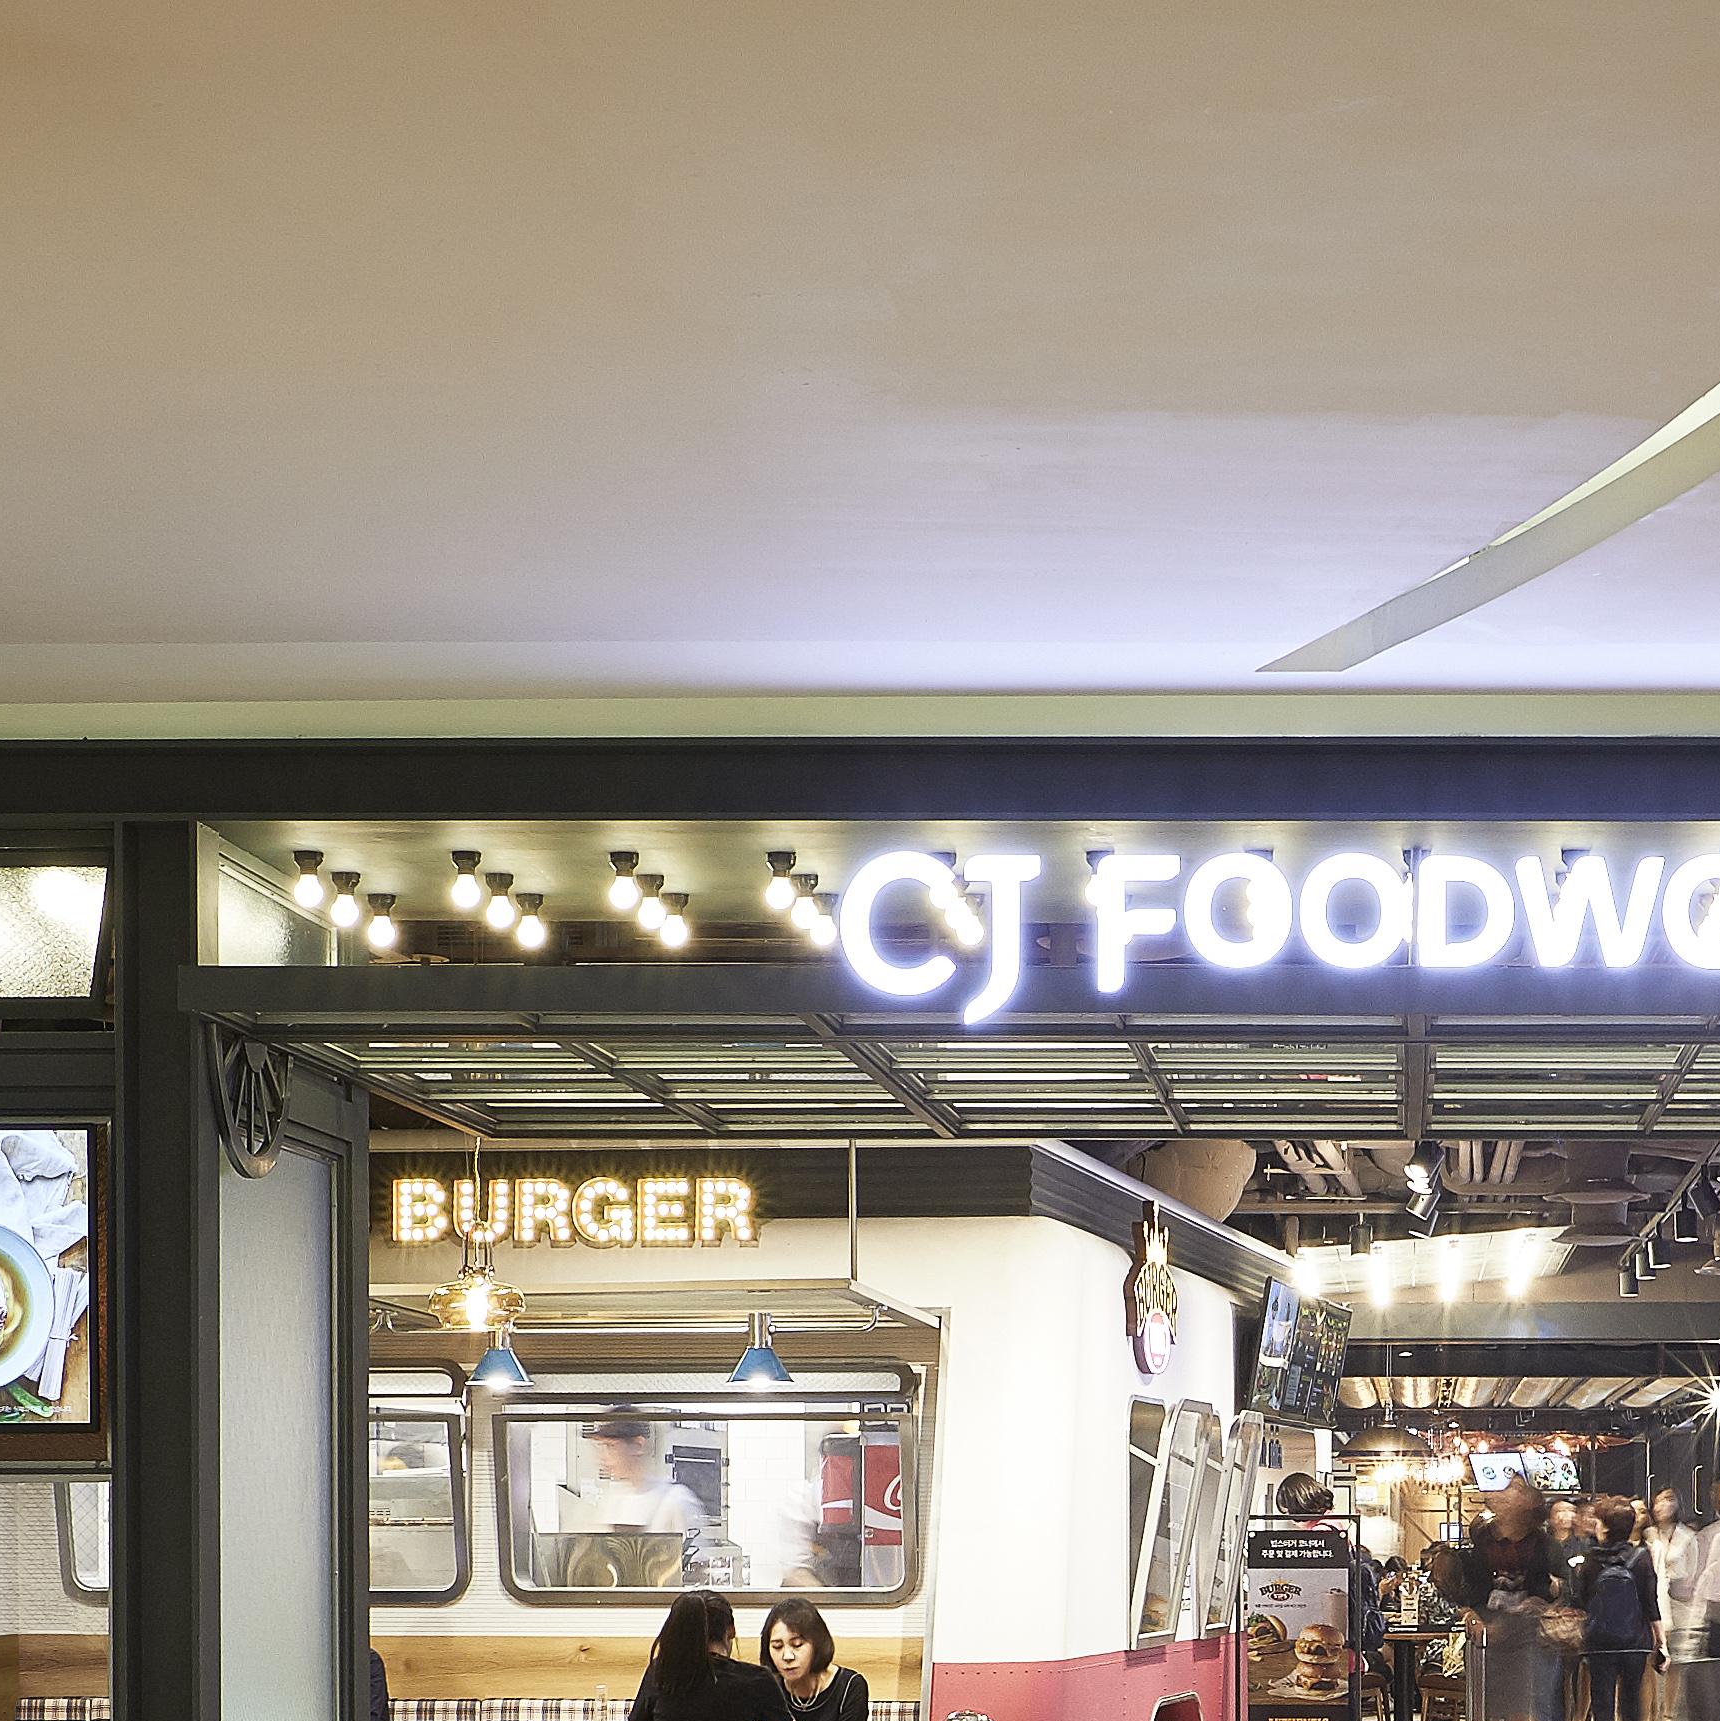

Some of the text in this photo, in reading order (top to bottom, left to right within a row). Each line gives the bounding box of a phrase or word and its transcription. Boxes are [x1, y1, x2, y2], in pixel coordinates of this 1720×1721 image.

[839, 850, 1042, 1026] CJ
[392, 1177, 759, 1246] BURGER
[1261, 1549, 1275, 1558] 주문
[1259, 1583, 1302, 1597] BURGER
